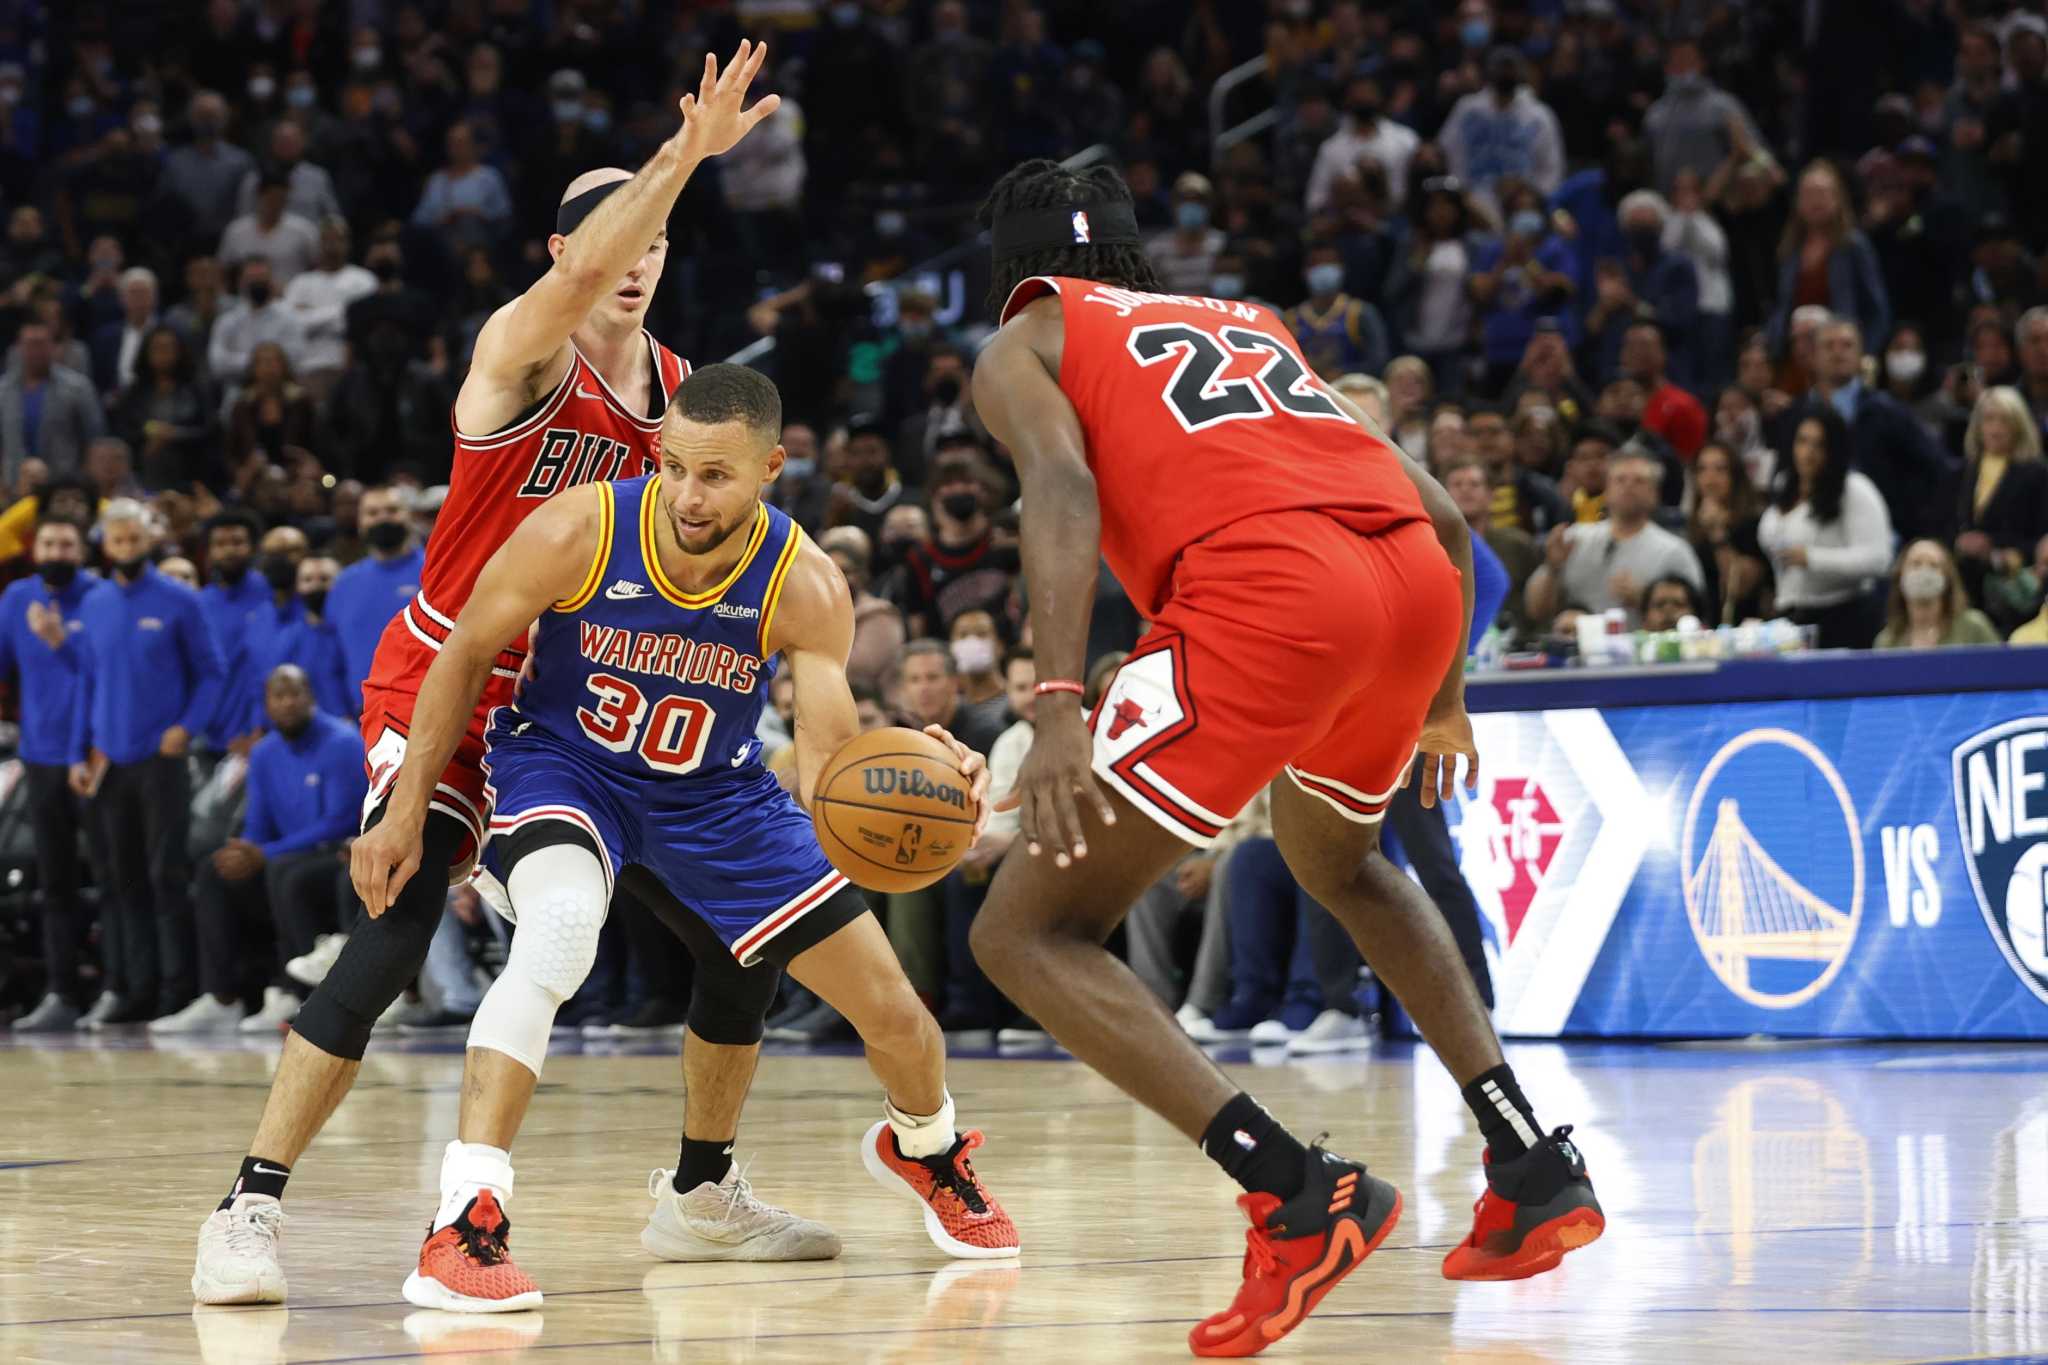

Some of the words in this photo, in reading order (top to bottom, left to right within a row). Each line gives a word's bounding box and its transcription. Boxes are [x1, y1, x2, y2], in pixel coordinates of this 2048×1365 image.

[1084, 286, 1260, 323] JOSON
[1126, 322, 1358, 433] 22
[612, 579, 645, 596] NIKE
[580, 620, 761, 695] WARRIORS
[576, 672, 717, 776] 30
[863, 767, 965, 811] Wilson
[1880, 823, 1943, 928] VS
